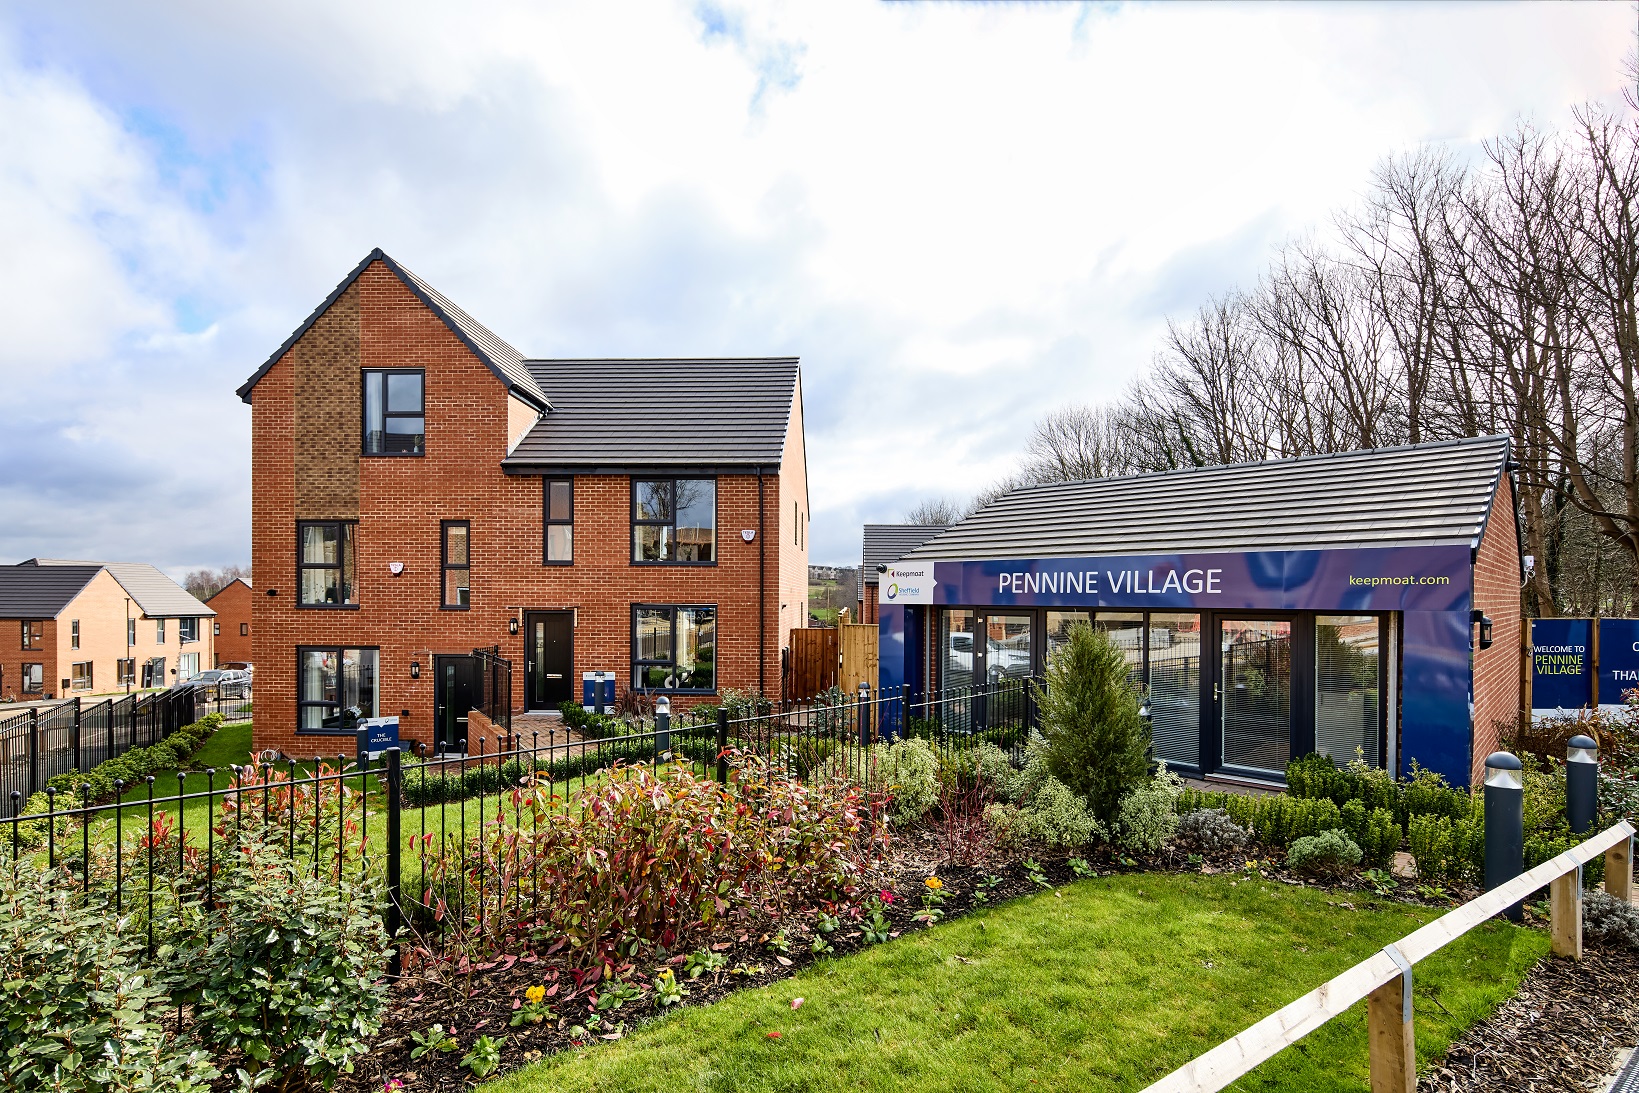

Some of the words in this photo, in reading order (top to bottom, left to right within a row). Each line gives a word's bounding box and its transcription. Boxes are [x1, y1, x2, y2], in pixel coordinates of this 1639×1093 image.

[999, 571, 1099, 593] PENNINE
[1107, 568, 1223, 593] VILLAGE
[1349, 574, 1450, 587] keepmoat.com
[1533, 645, 1573, 653] WELCOME
[1574, 645, 1585, 653] TO
[1535, 654, 1584, 665] PENNINE
[1536, 665, 1582, 675] VILLAGE
[1612, 670, 1639, 681] THA
